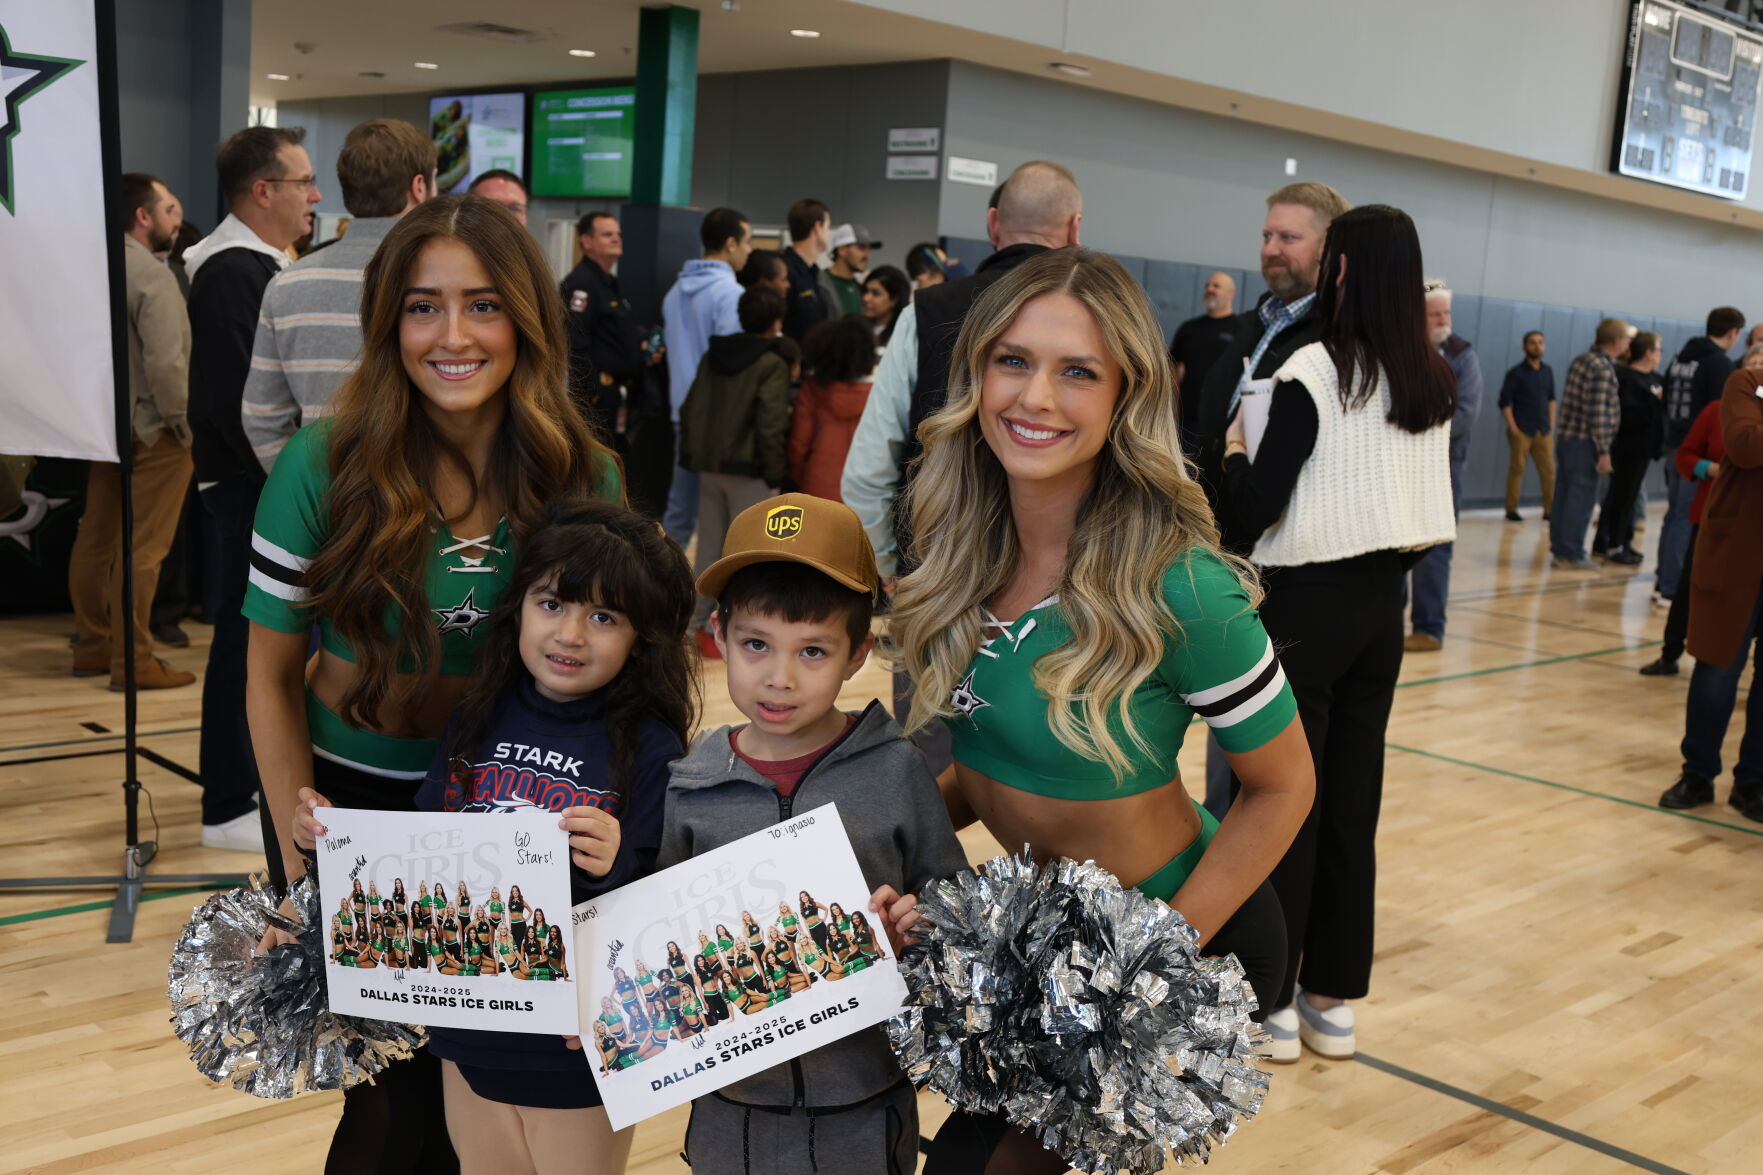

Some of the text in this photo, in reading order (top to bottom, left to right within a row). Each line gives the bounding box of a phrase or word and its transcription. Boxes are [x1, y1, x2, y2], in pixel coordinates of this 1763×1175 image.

[768, 516, 801, 536] ups
[494, 742, 584, 777] STARK
[407, 828, 465, 854] ICE
[516, 848, 554, 866] Stars!
[369, 842, 502, 898] GIRLS
[670, 860, 737, 908] ICE
[631, 858, 787, 965] GIRLS
[360, 988, 534, 1012] DALLAS STARS ICE GIRLS
[410, 984, 471, 996] 2024-2025
[650, 1056, 717, 1092] DALLAS
[719, 1032, 775, 1063] STARS
[778, 1018, 806, 1039] ICE
[809, 996, 860, 1025] GIRLS
[715, 1015, 788, 1051] 2024-2025
